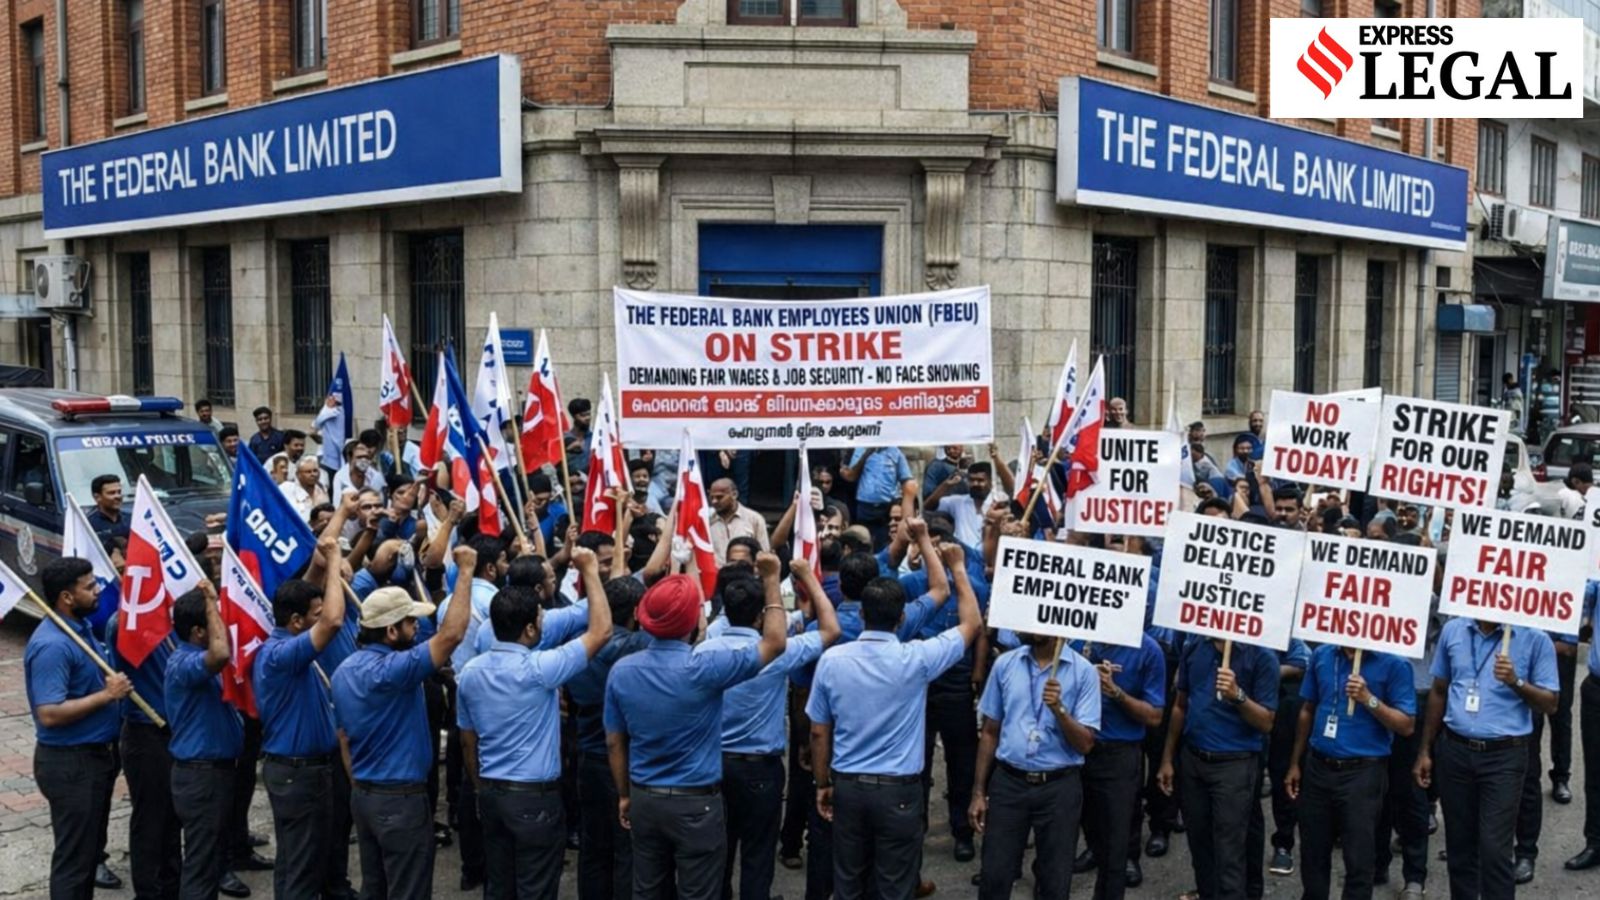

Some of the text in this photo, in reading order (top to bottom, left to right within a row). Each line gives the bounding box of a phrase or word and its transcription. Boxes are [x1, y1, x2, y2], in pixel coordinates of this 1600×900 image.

[58, 109, 397, 205] THE FEDERAL BANK LIMITED
[1097, 108, 1435, 218] THE FEDERAL BANK LIMITED
[626, 302, 979, 328] THE FEDERAL BANK EMPLOYEES UNION (FBEU)
[705, 330, 902, 363] ON STRIKE
[700, 367, 726, 386] FAIR
[728, 368, 770, 386] WAGES
[783, 367, 807, 386] JOB
[809, 366, 864, 386] SECURITY
[875, 365, 892, 384] NO
[895, 365, 925, 383] FACE
[926, 362, 980, 383] SHOWING
[1306, 400, 1340, 426] NO
[1392, 403, 1499, 445] STRIKE
[1100, 437, 1159, 464] UNITE
[1291, 424, 1351, 451] WORK
[1390, 437, 1490, 473] FOR OUR
[1109, 468, 1149, 494] FOR
[1273, 446, 1359, 482] TODAY!
[1381, 464, 1487, 507] RIGHTS!
[1188, 522, 1277, 555] JUSTICE
[1461, 512, 1493, 538] WE
[1497, 518, 1586, 551] DEMAND
[1002, 547, 1145, 588] FEDERAL BANK
[1183, 543, 1275, 579] DELAYED
[1311, 539, 1429, 576] WE DEMAND
[1477, 545, 1547, 582] FAIR
[1012, 574, 1130, 610] EMPLOYEES'
[1178, 580, 1266, 613] JUSTICE
[1218, 571, 1234, 588] IS
[1324, 571, 1392, 608] FAIR
[1450, 576, 1574, 621] PENSIONS
[1037, 603, 1098, 631] UNION
[1180, 602, 1263, 637] DENIED
[1301, 602, 1418, 646] PENSIONS
